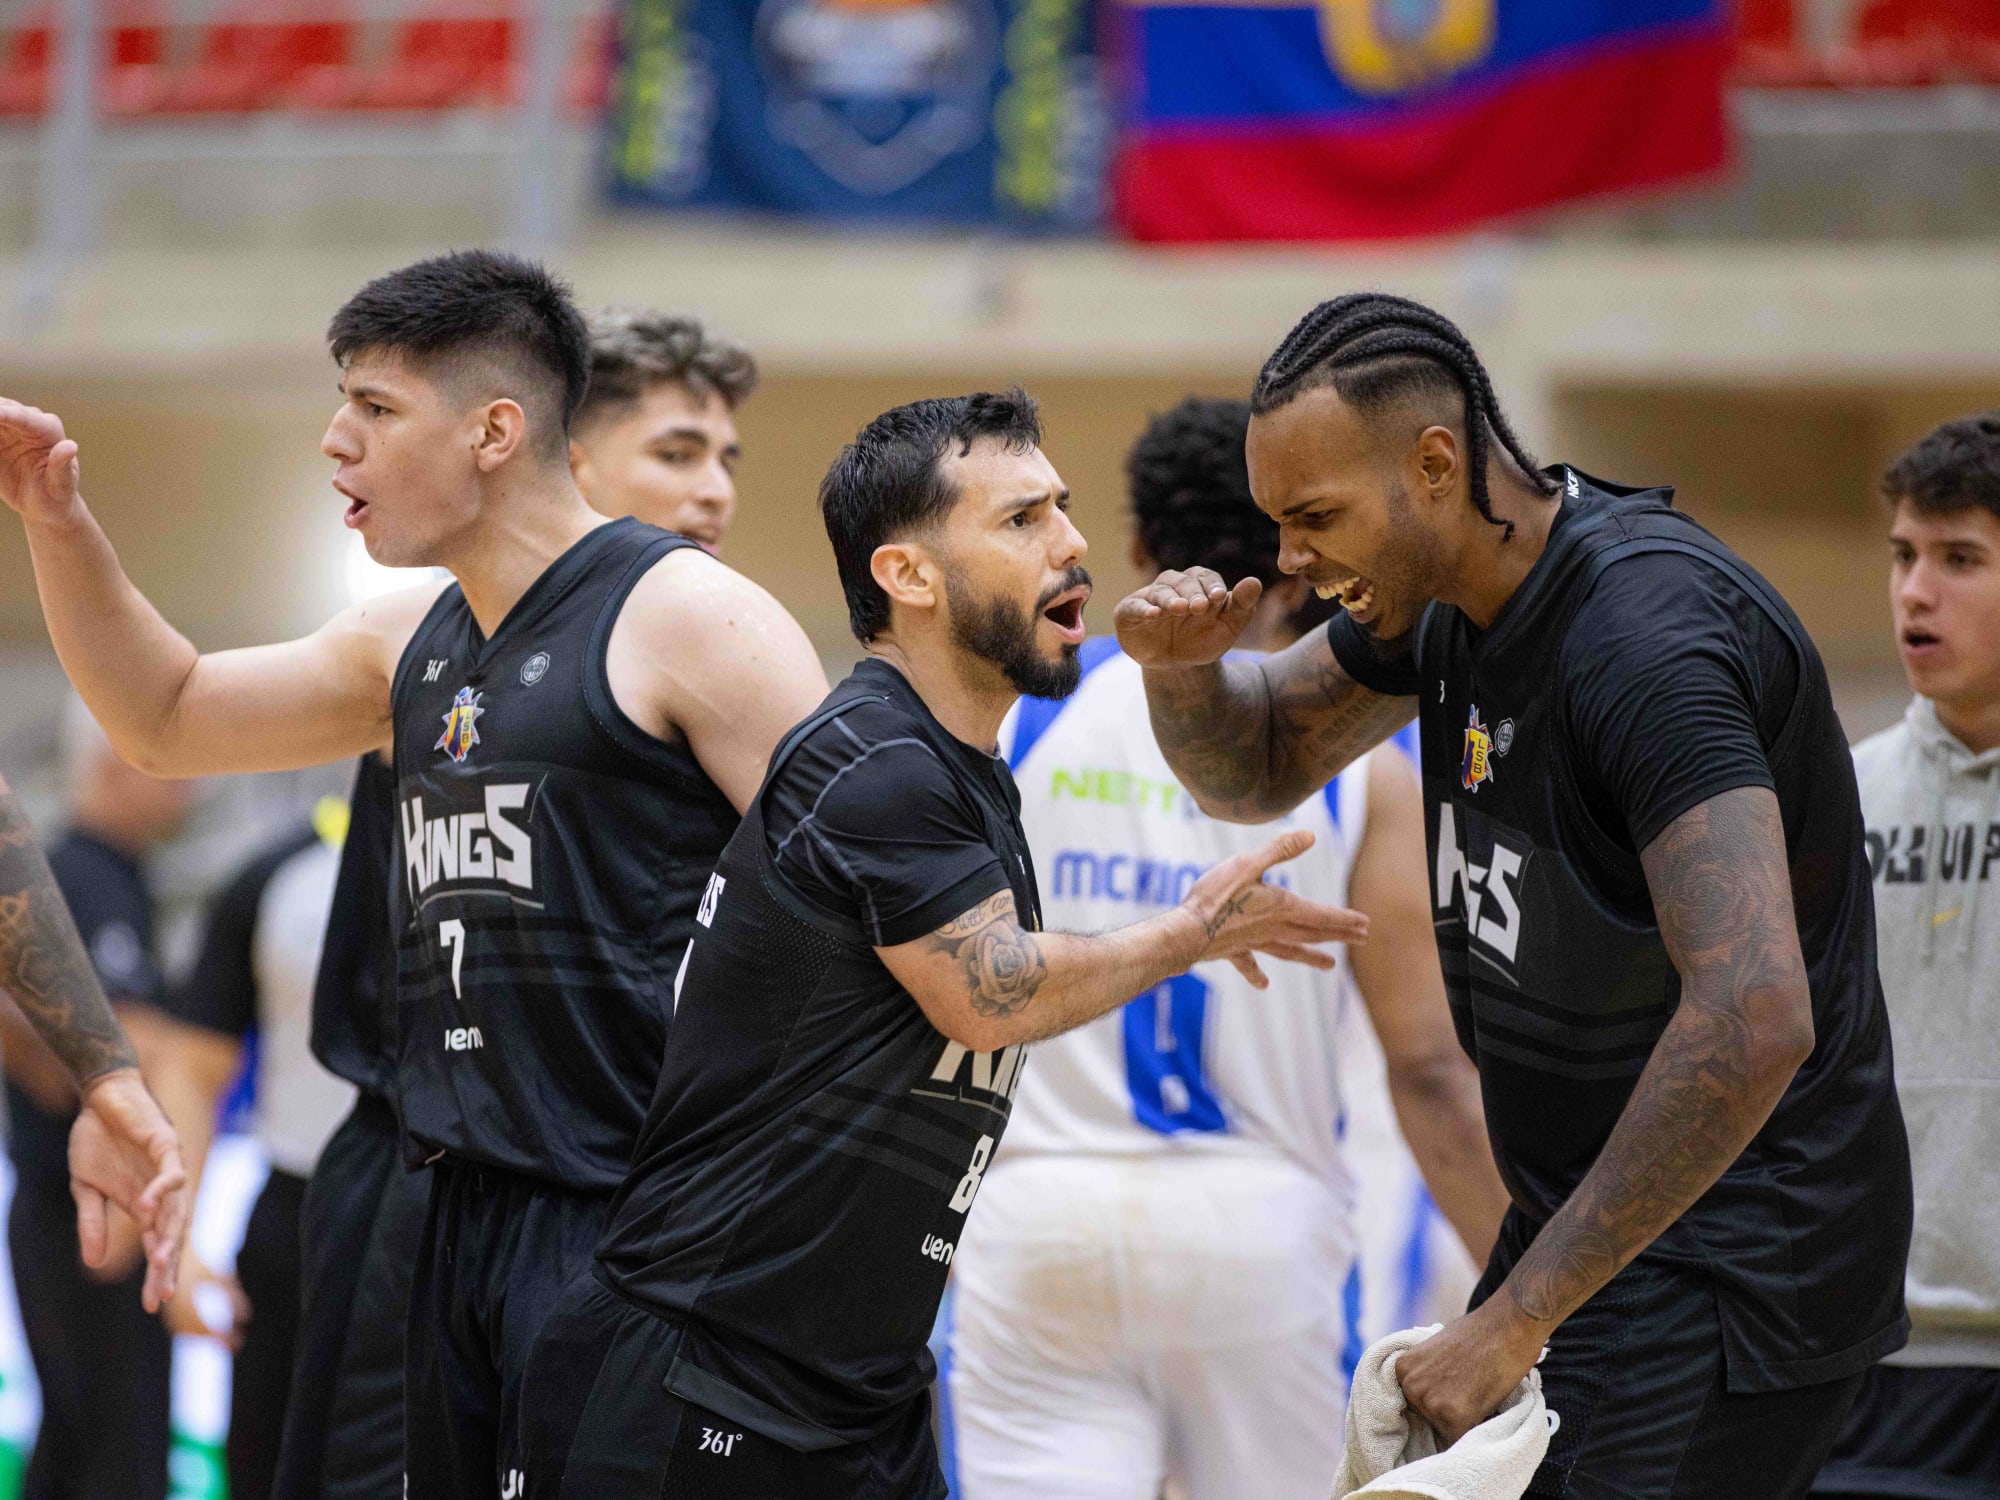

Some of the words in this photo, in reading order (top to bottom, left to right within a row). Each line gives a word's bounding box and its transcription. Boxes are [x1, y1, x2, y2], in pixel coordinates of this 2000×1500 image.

[1473, 738, 1486, 775] LSB
[401, 783, 533, 905] KINGS
[439, 918, 466, 1000] 7
[947, 1133, 995, 1214] 8
[697, 1426, 744, 1457] 361°
